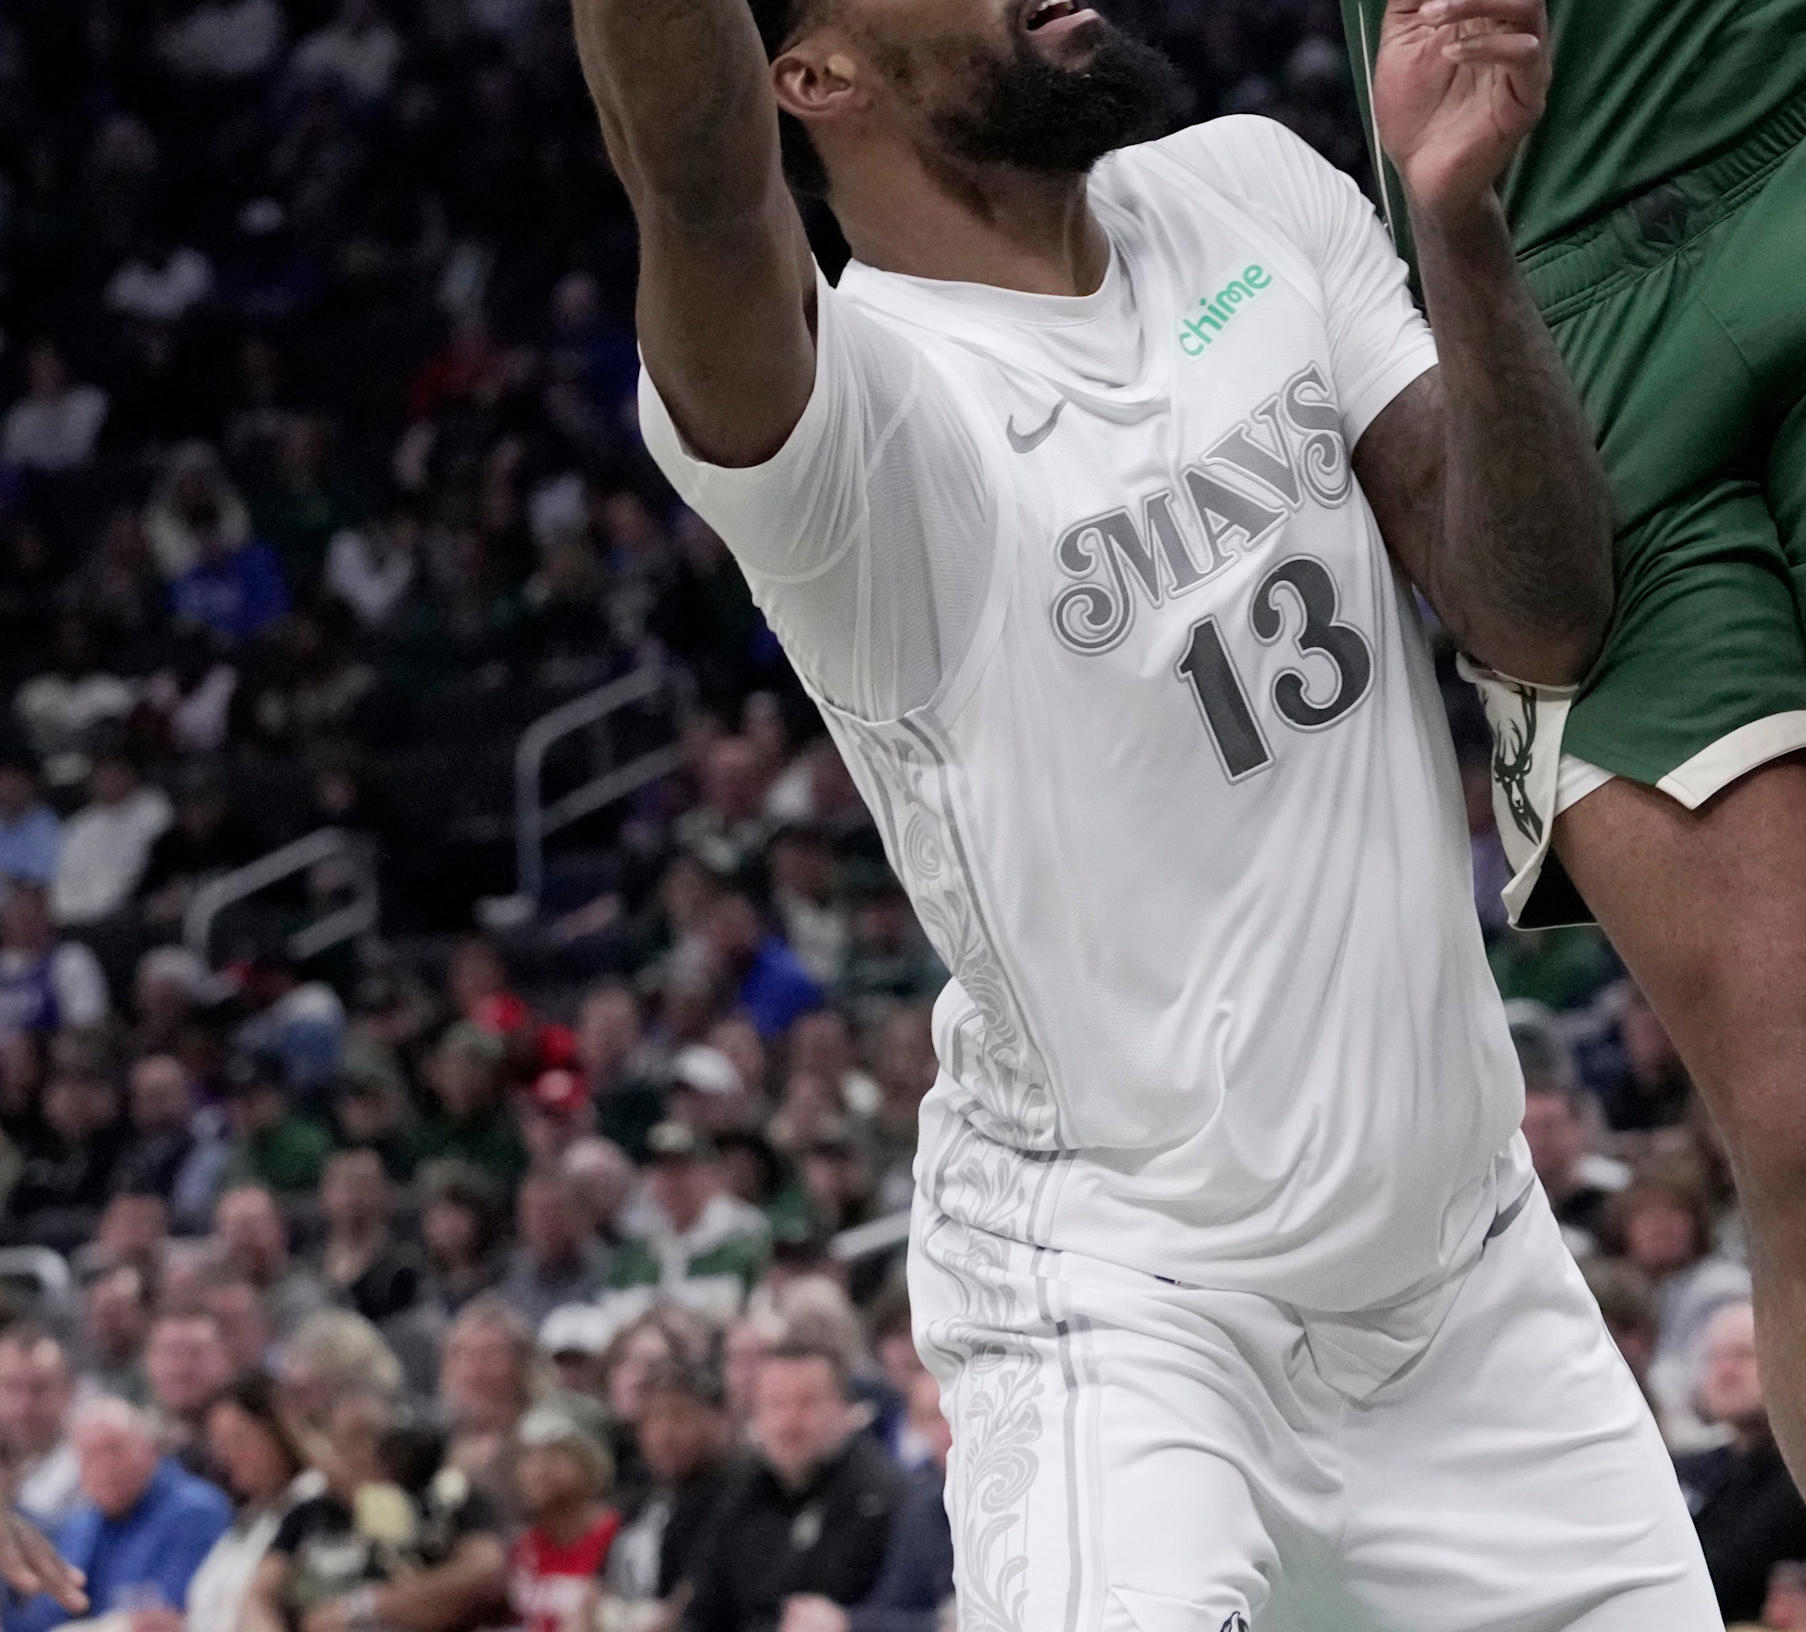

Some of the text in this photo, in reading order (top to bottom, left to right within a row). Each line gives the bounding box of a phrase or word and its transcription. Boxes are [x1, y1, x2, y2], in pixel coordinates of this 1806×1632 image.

[1178, 262, 1273, 358] chime
[1052, 359, 1354, 658] MAVS
[1175, 552, 1376, 786] 13
